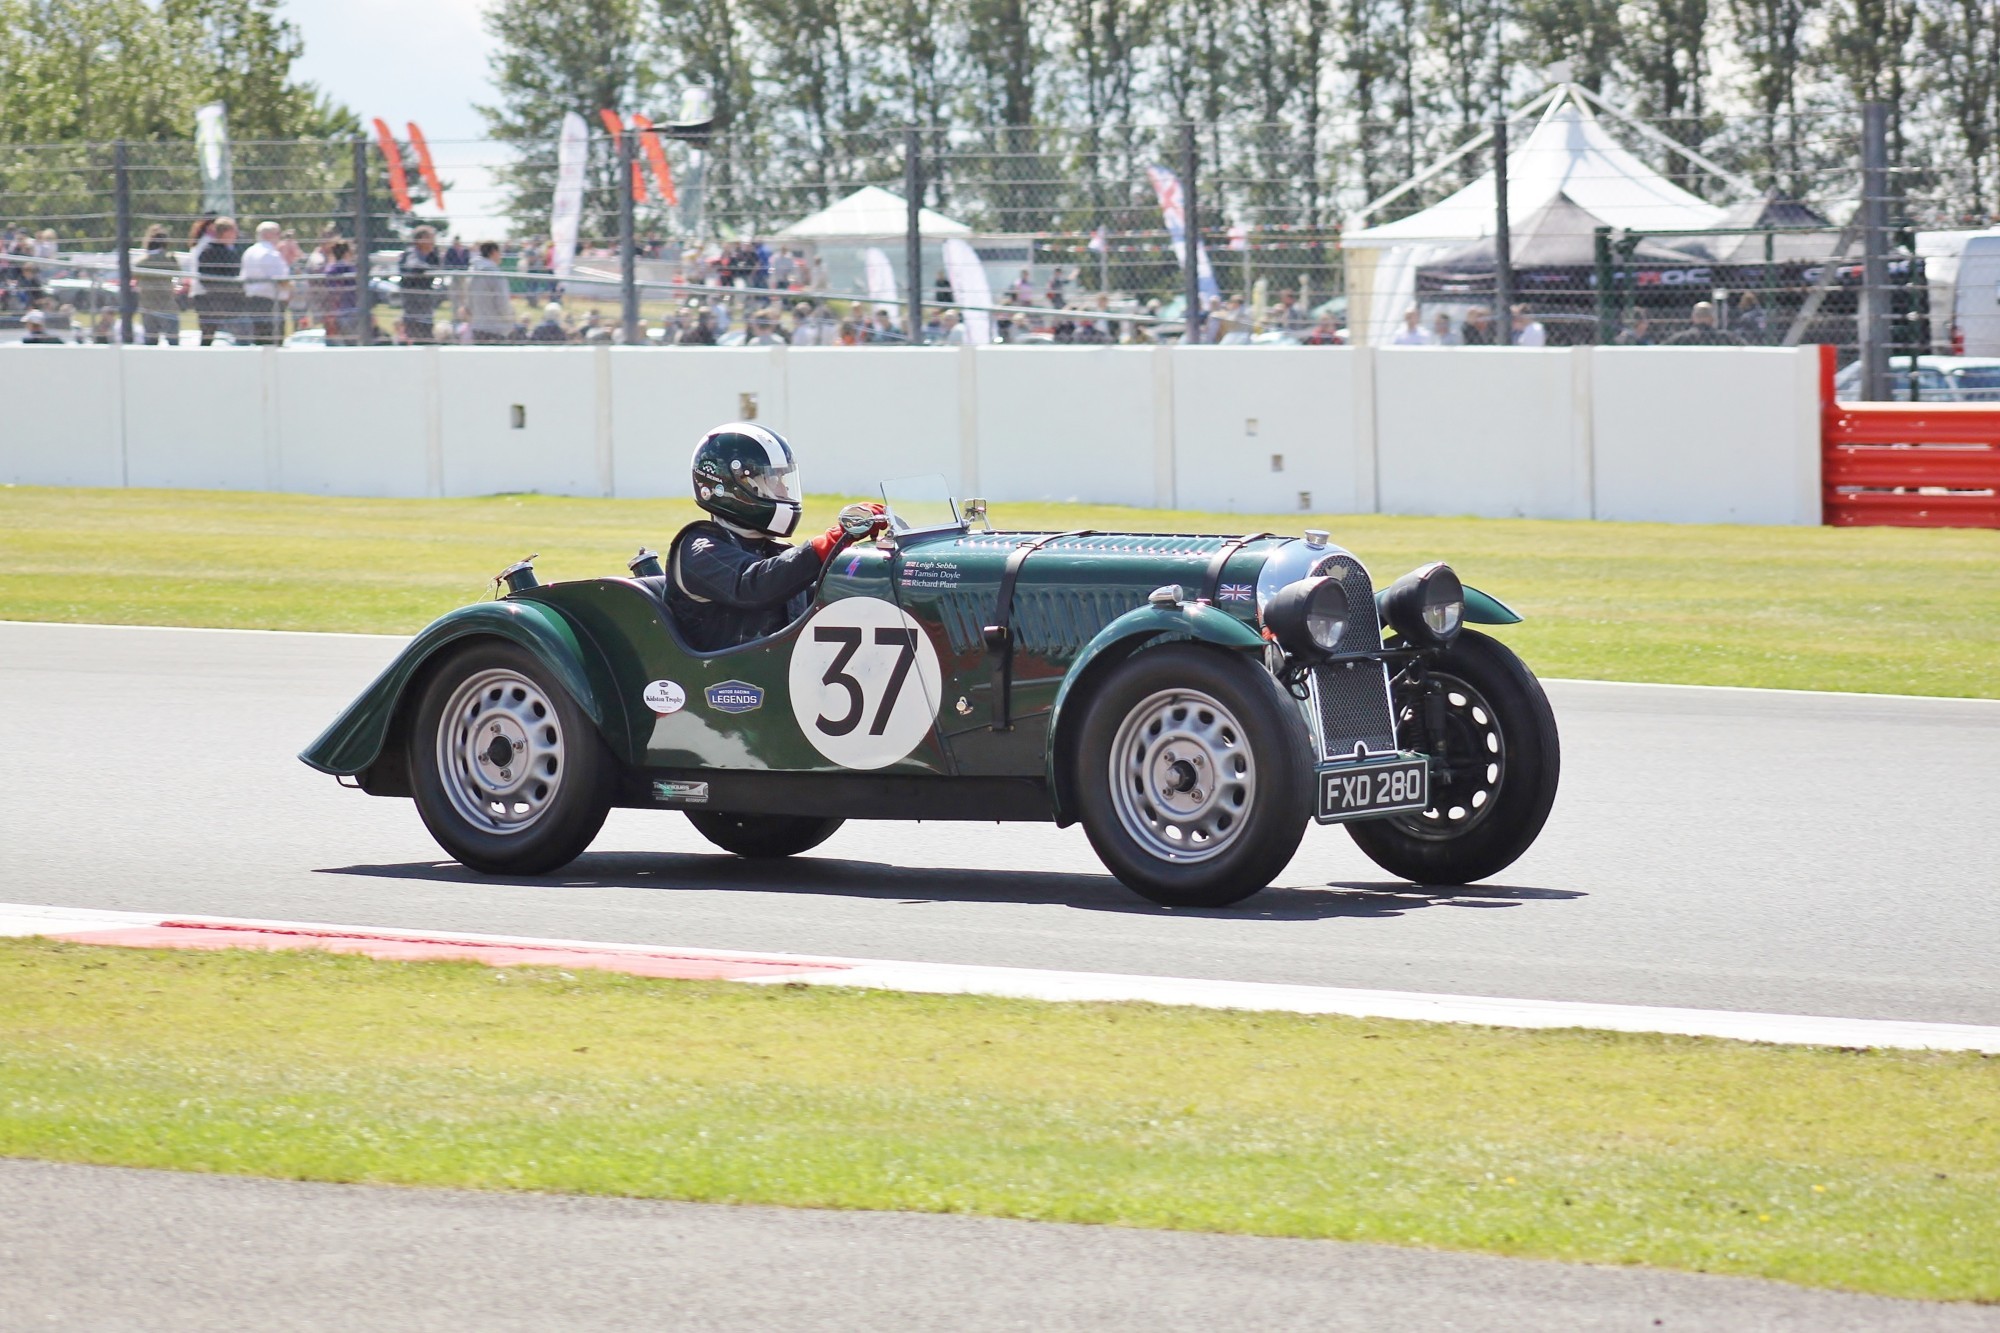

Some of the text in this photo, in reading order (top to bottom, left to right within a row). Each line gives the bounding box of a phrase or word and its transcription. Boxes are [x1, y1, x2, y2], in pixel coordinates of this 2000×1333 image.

[915, 561, 957, 570] Leigh Sebba
[914, 569, 961, 580] Tamsin Doyle
[911, 579, 957, 589] Richard Plant
[814, 626, 918, 737] 37
[665, 696, 683, 704] Trophy
[711, 695, 758, 704] LEGENDS
[1326, 768, 1421, 810] FXD 280
